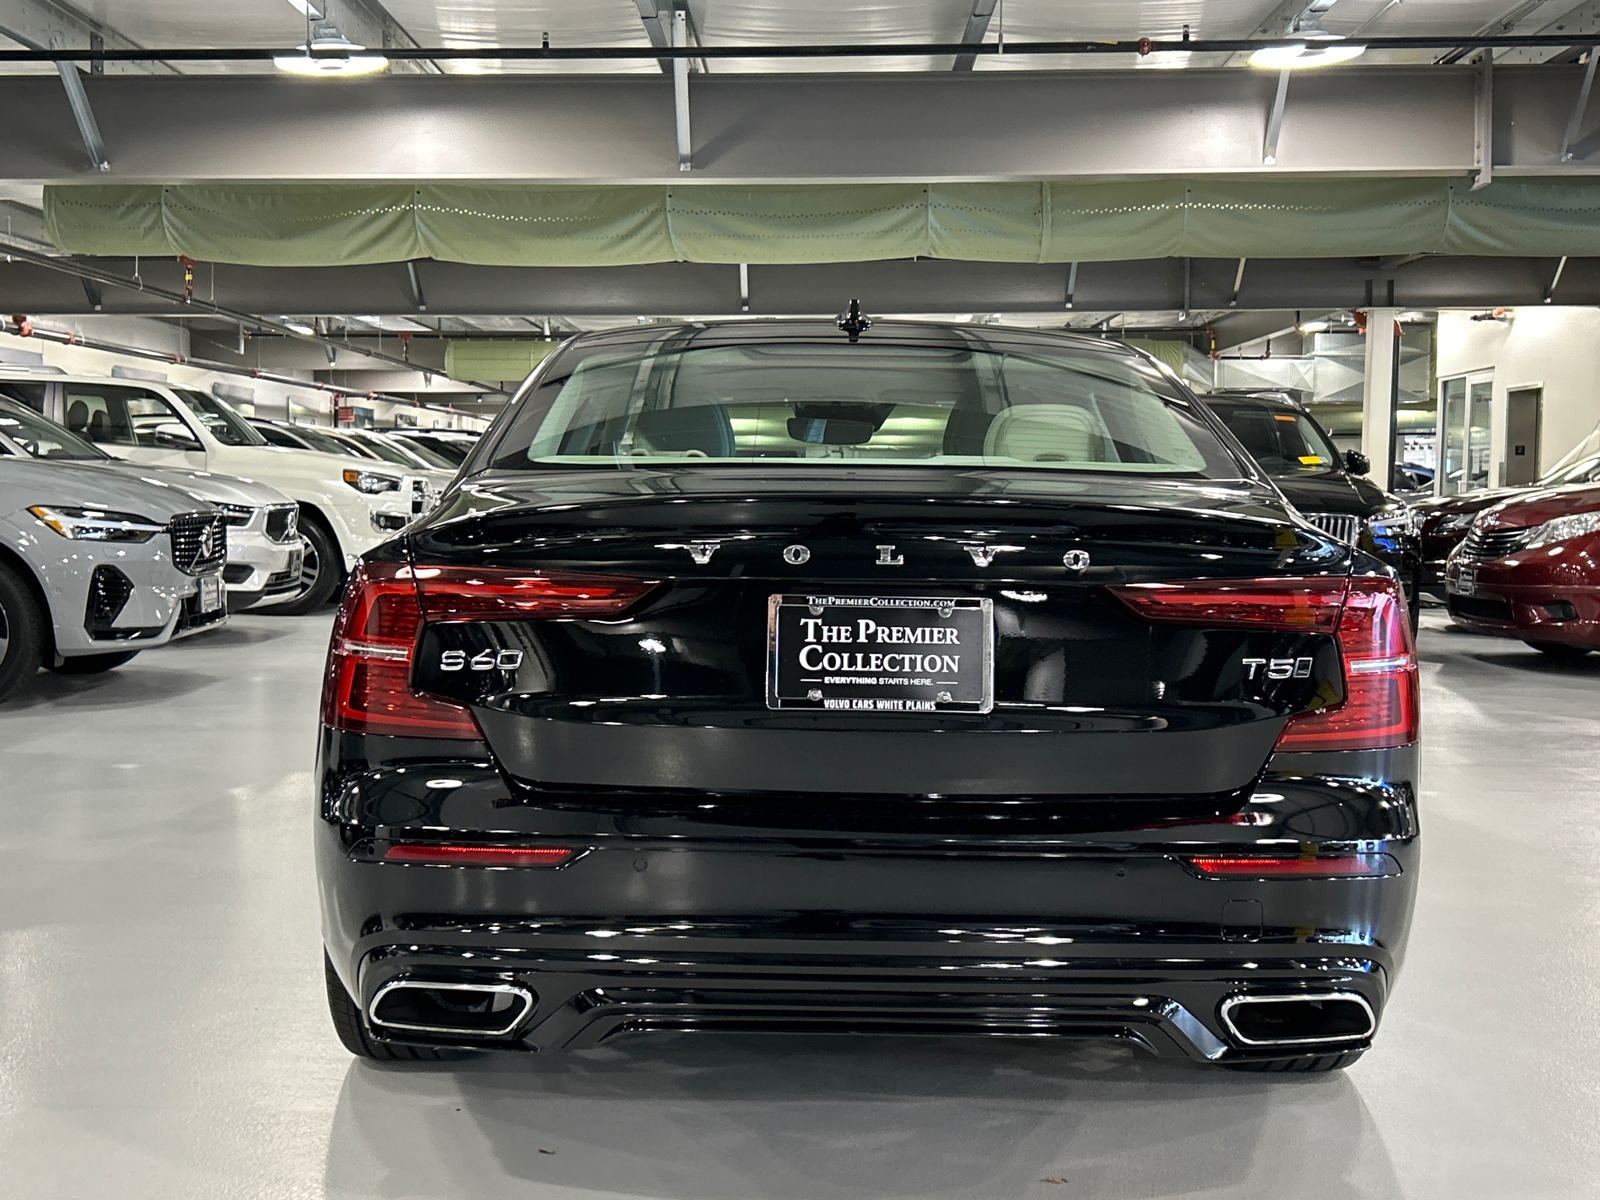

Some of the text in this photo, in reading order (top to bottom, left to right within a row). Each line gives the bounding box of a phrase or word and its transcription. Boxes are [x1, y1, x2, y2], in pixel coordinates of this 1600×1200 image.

[683, 544, 1091, 571] VOLVO
[800, 618, 960, 645] THE PREMIER
[440, 648, 524, 671] S60
[799, 645, 960, 673] COLLECTION
[824, 676, 934, 686] EVERYTHING STARTS HERE.
[824, 699, 937, 711] VOLVO CARS WHITE PLAINS
